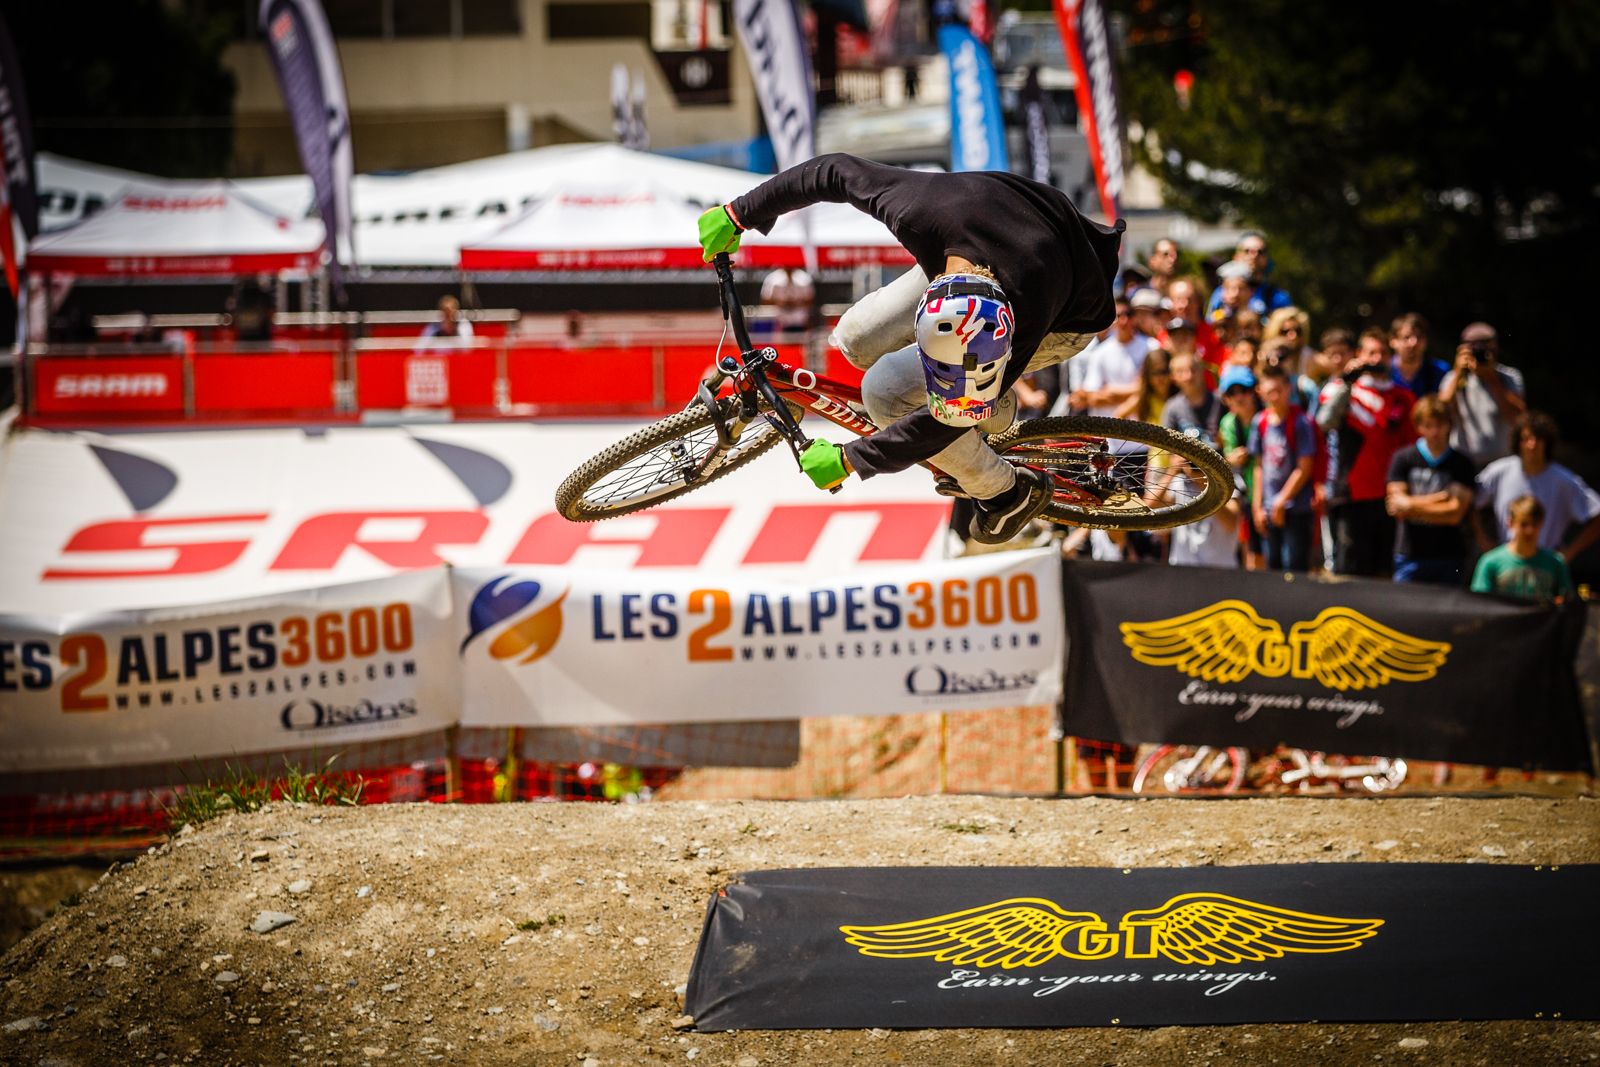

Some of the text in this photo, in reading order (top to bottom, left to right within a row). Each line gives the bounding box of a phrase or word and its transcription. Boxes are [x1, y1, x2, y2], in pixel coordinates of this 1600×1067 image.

[53, 373, 168, 398] SRAM
[41, 502, 951, 581] SRAM
[1053, 919, 1169, 961] GT
[937, 968, 1277, 998] Earn your wings.
